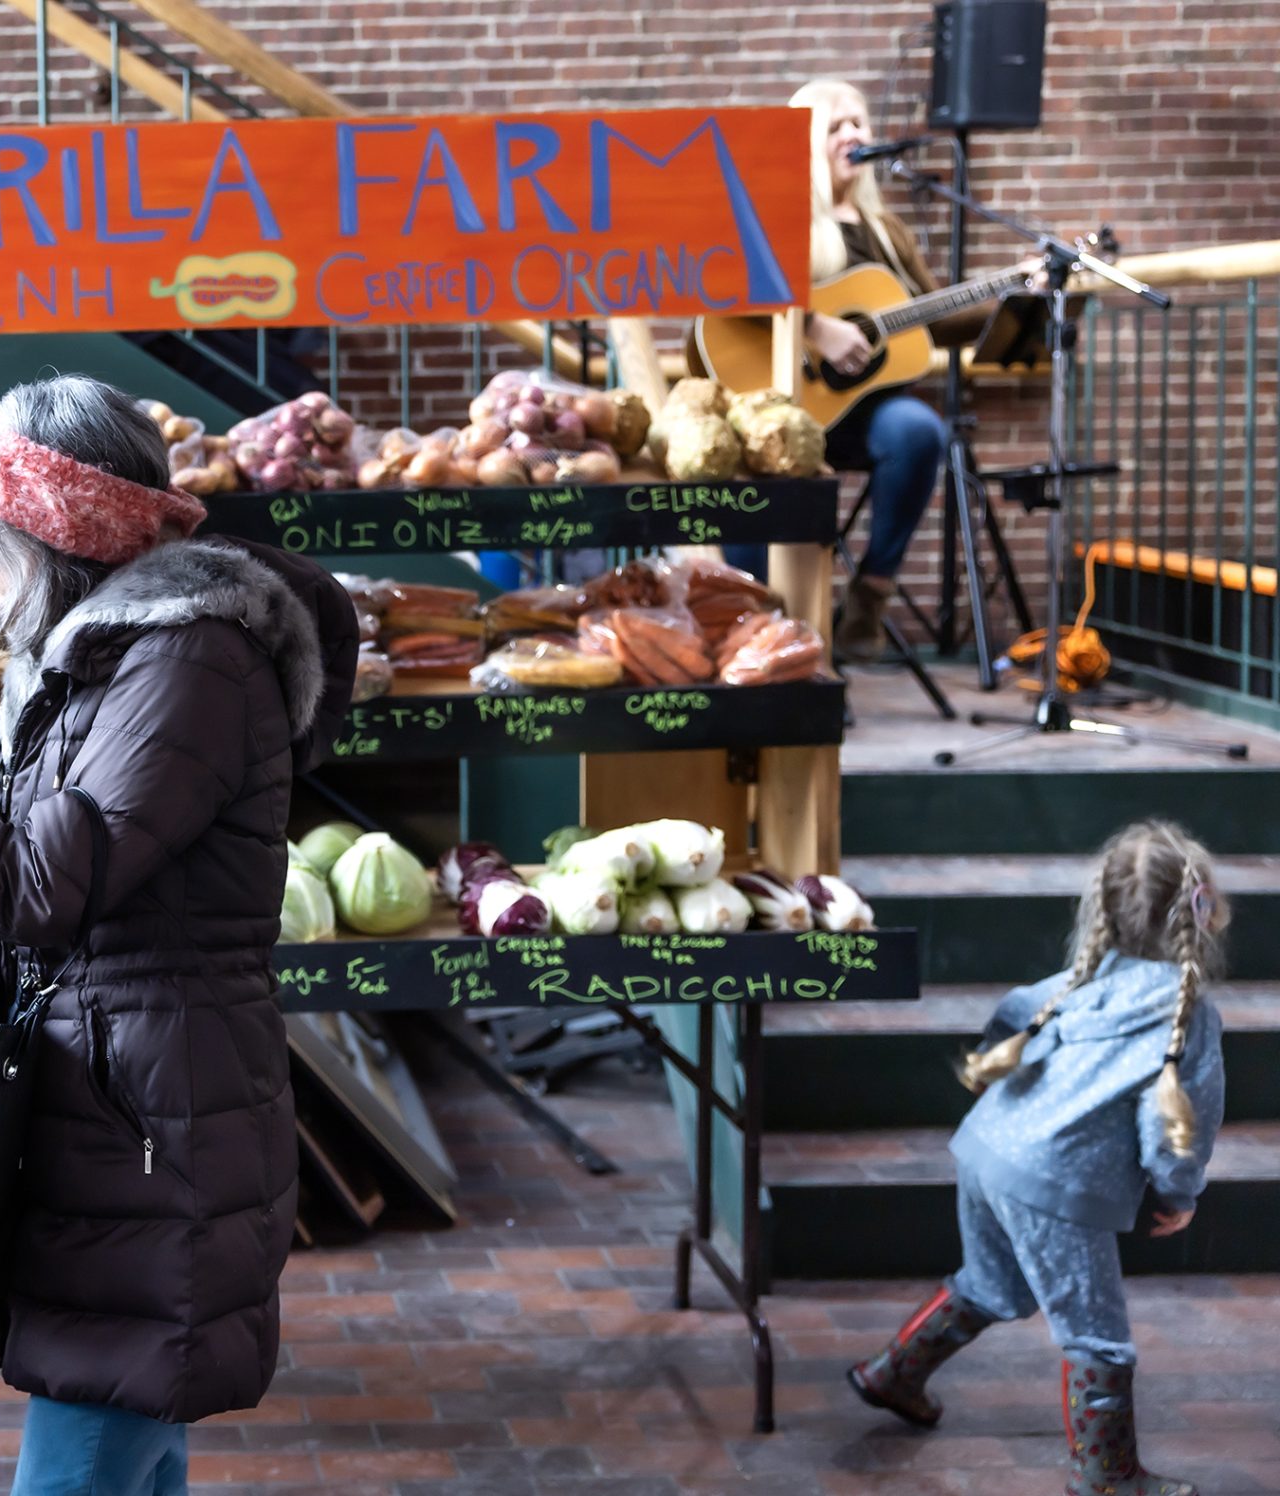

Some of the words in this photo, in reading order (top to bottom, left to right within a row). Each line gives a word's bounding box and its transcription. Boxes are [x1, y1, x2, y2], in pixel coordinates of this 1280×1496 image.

[336, 115, 795, 306] FARM
[511, 243, 738, 316] ORGANIC
[625, 486, 769, 513] CELERIAC
[528, 968, 847, 1002] RADICCHIO!
